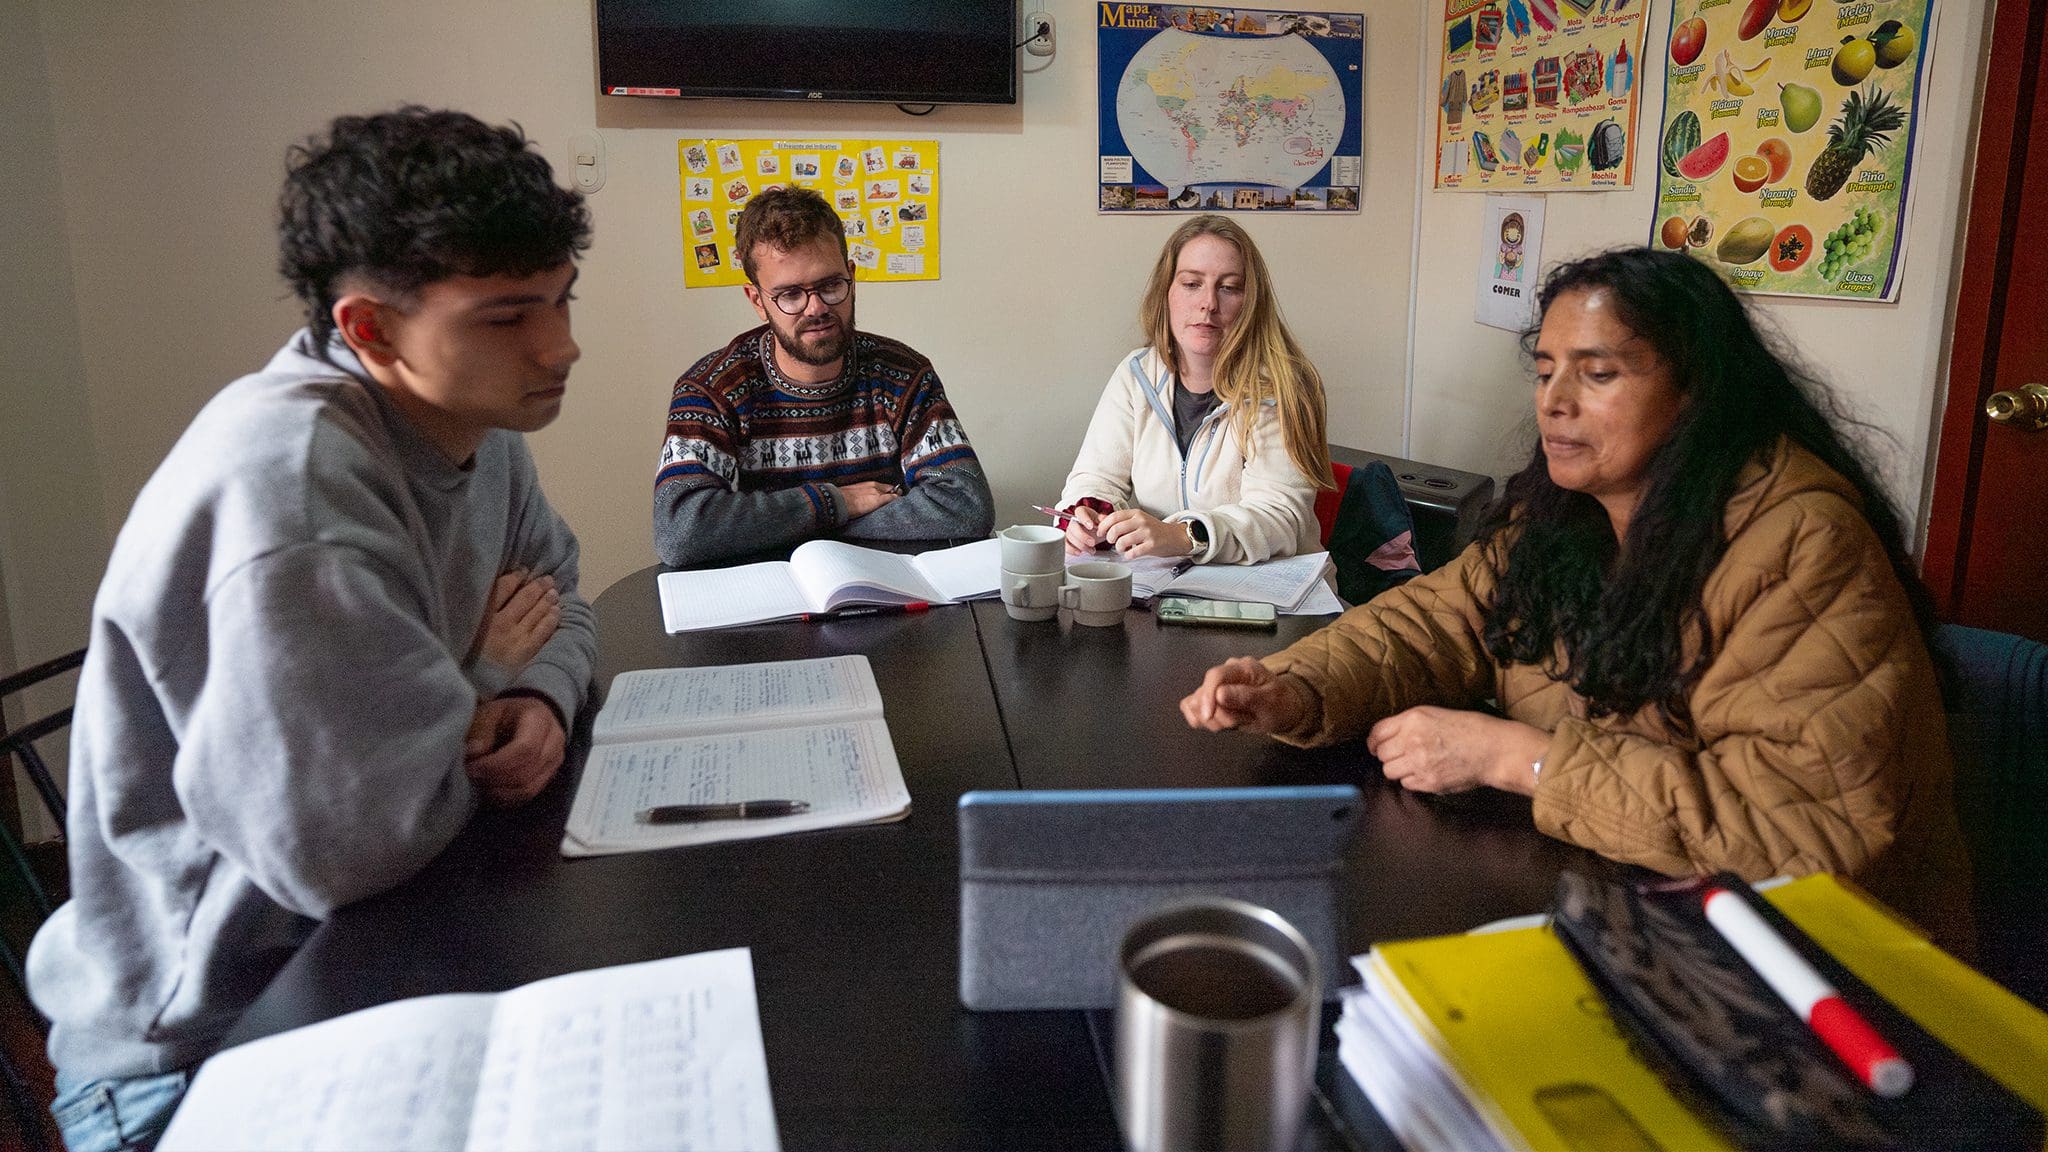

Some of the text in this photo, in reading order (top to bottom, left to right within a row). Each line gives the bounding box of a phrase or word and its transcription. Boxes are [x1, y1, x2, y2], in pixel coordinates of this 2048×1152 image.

[1837, 3, 1874, 19] Melón
[1764, 26, 1798, 39] Mango
[1806, 48, 1833, 60] Lima
[1757, 108, 1779, 119] Pera
[1858, 170, 1885, 182] Piña
[1846, 180, 1896, 193] (Pineapple)
[1759, 187, 1798, 199] Naranja
[1845, 271, 1874, 283] Uvas
[1492, 284, 1521, 298] COMER
[1836, 281, 1875, 292] (Grapes)
